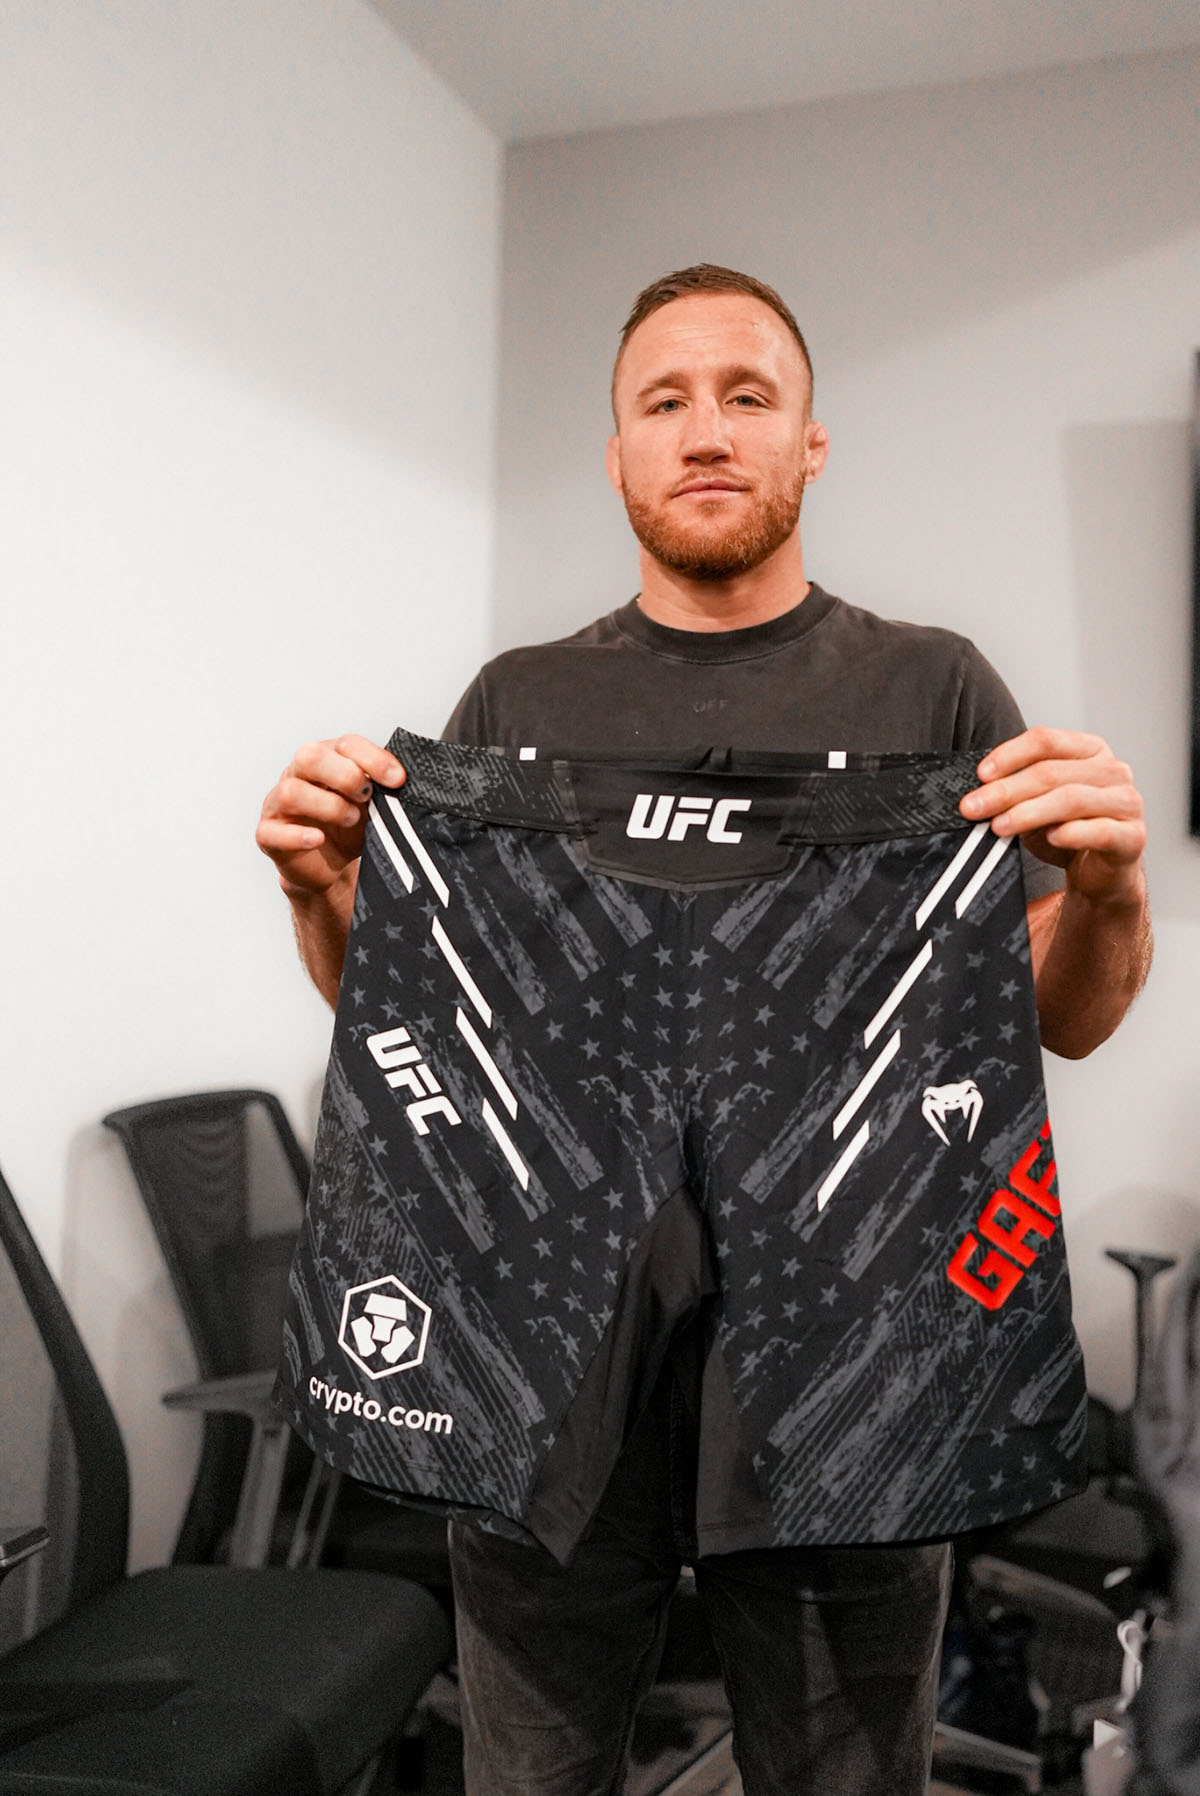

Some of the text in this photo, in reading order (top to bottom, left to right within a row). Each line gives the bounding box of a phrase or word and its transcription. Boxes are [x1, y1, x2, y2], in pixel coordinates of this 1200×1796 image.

[626, 794, 752, 844] UFC
[366, 1026, 462, 1136] UFC
[309, 1376, 454, 1435] crypto.com
